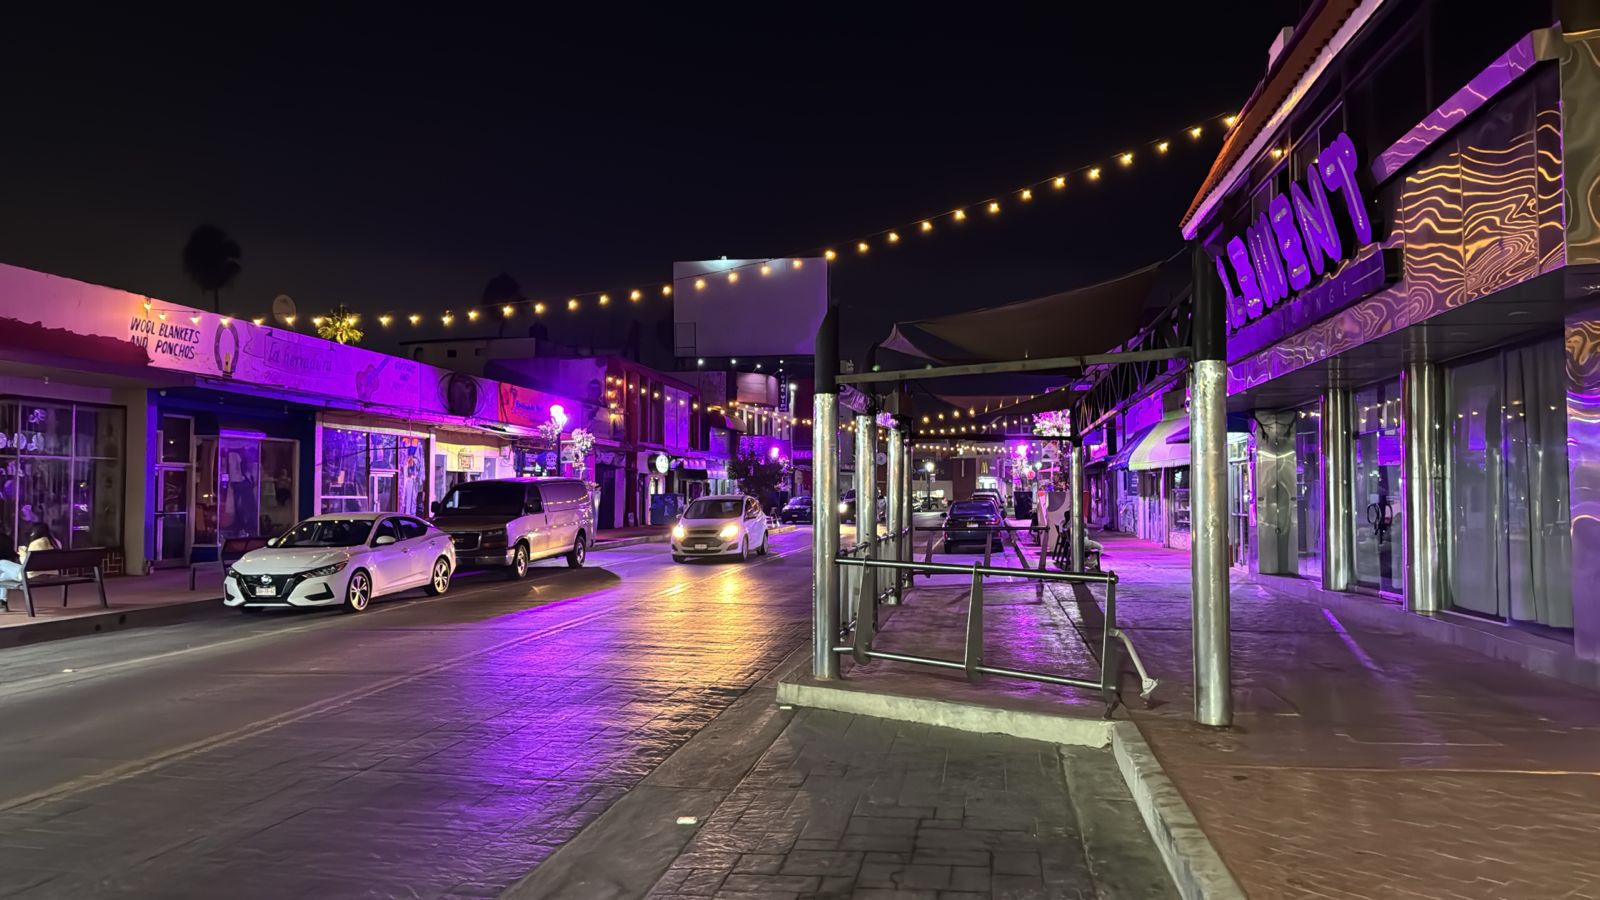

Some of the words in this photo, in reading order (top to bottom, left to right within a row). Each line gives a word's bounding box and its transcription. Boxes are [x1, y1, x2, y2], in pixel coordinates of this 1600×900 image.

[1216, 132, 1372, 334] LEMENT
[130, 317, 156, 335] WOOL
[158, 323, 201, 344] BLANKETS
[154, 340, 195, 360] PONCHOS
